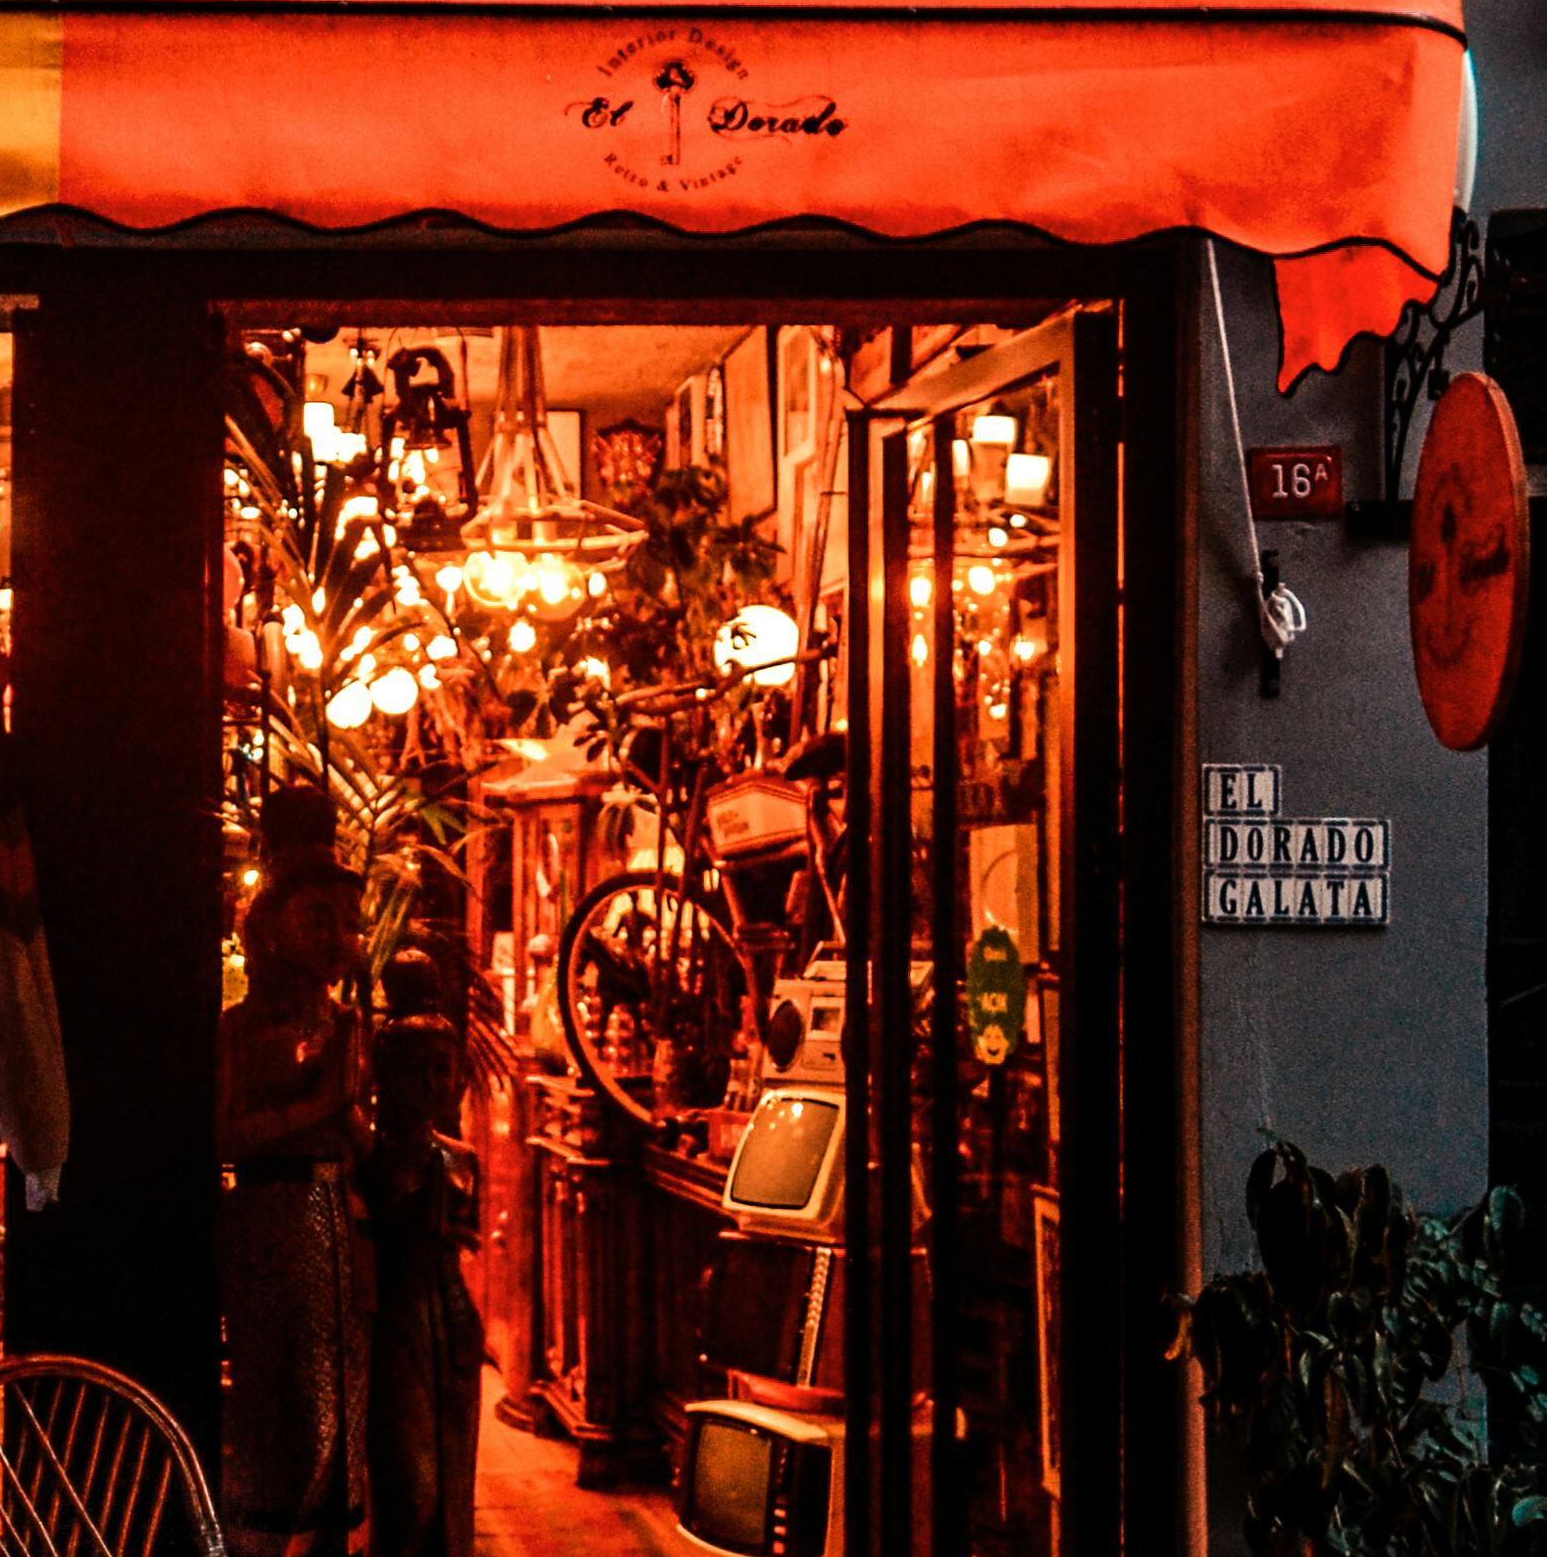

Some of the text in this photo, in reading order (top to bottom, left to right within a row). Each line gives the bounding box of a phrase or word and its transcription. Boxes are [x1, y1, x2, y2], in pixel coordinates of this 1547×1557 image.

[597, 27, 749, 80] Interior Design
[565, 95, 849, 145] El Dorado
[604, 151, 649, 189] Retro
[679, 155, 743, 192] Vintage
[1220, 772, 1263, 810] EL
[1219, 825, 1375, 864] DORADO
[1218, 879, 1372, 917] GALATA
